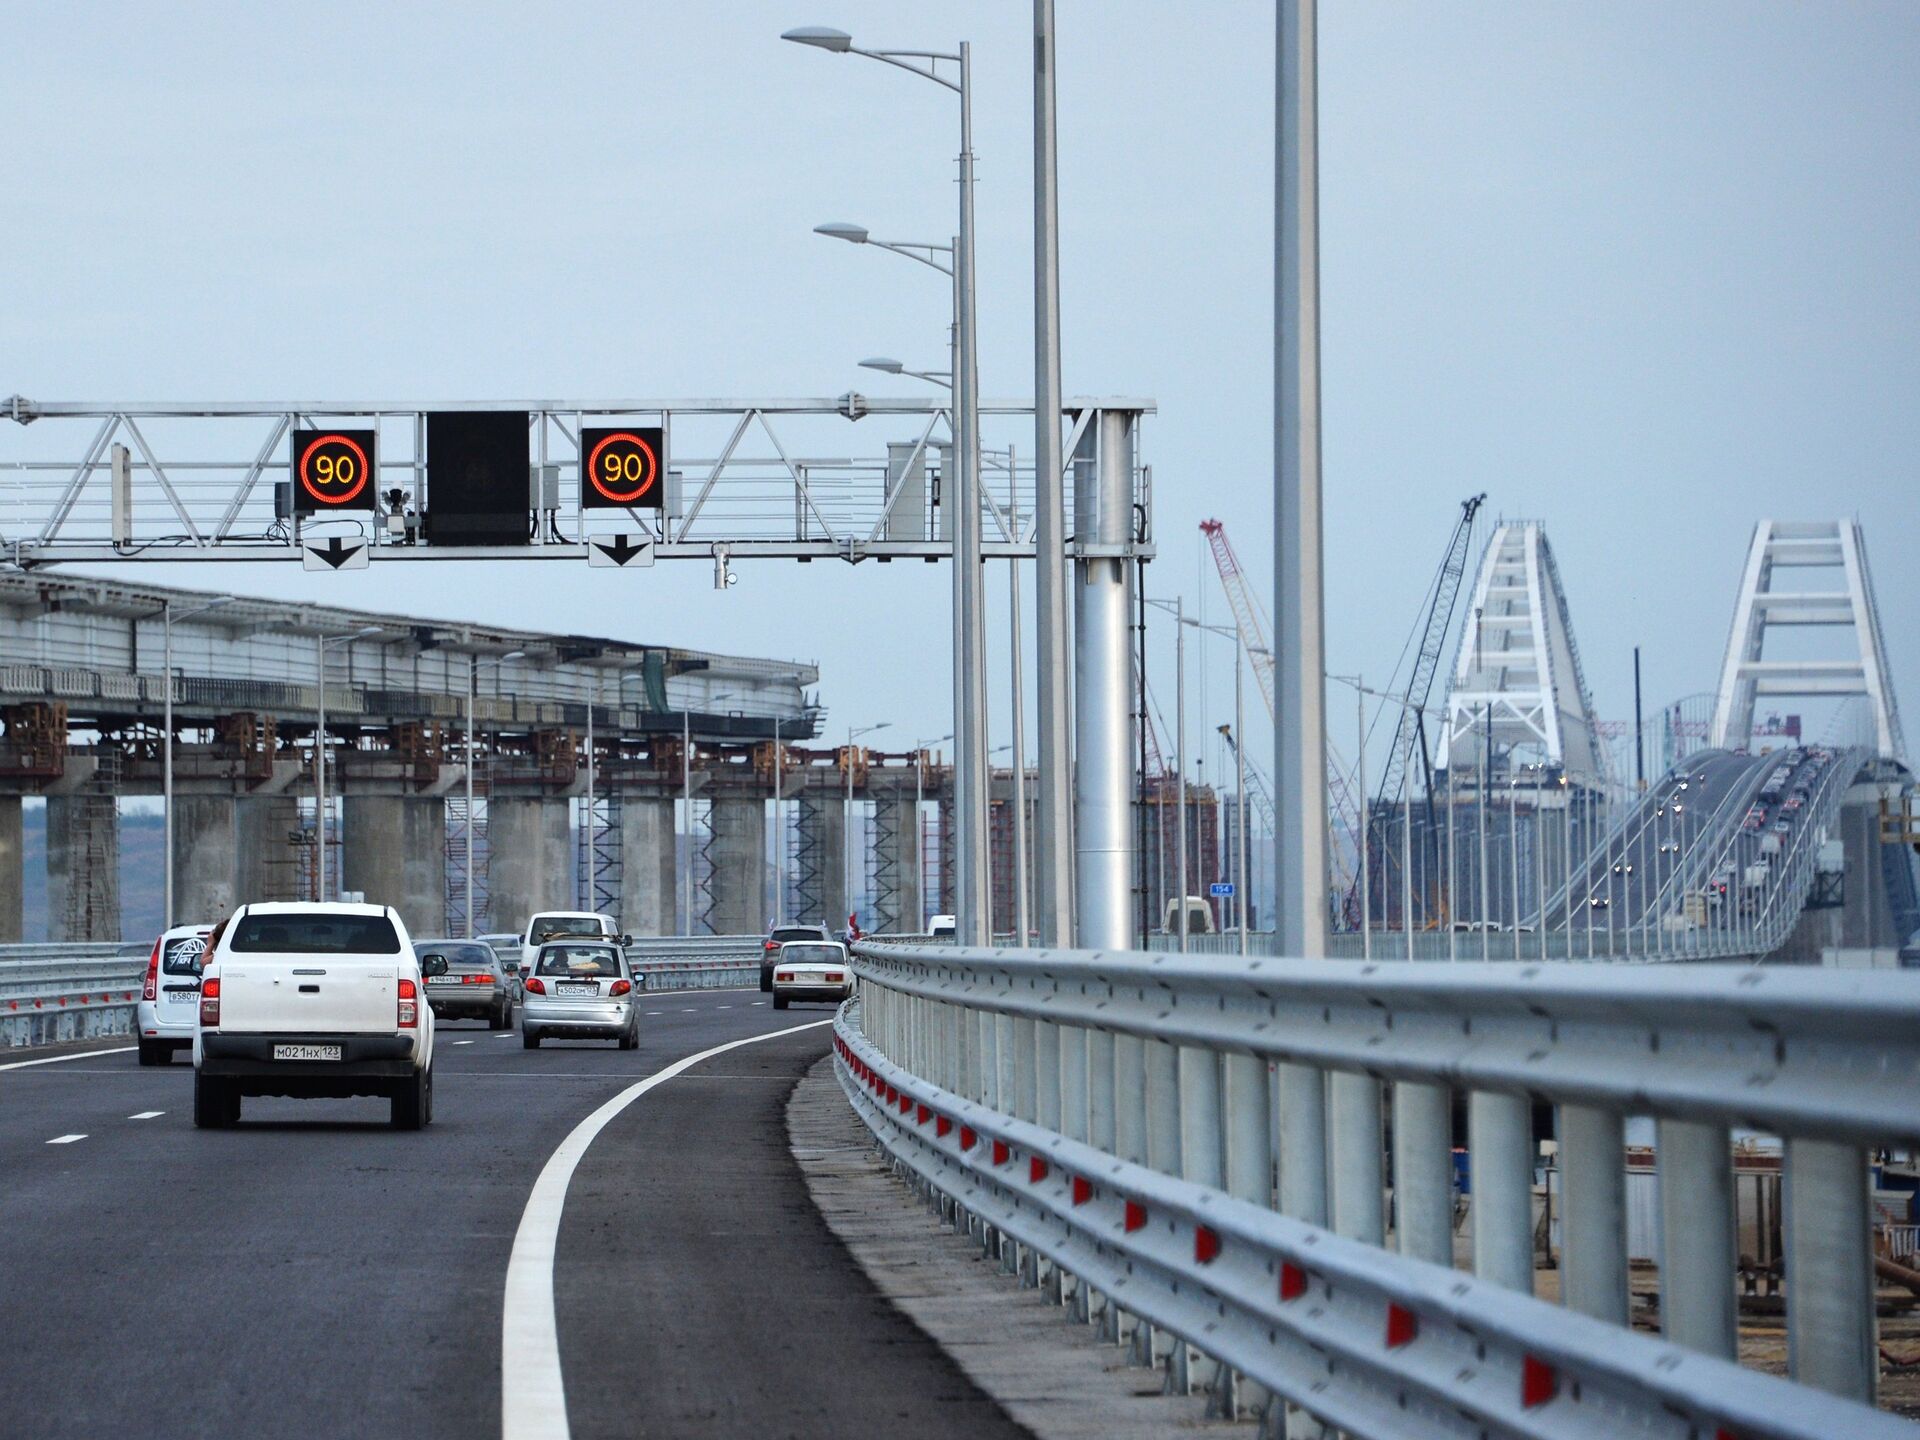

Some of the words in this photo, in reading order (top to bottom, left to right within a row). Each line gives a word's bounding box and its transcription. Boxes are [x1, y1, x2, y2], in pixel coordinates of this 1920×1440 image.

[316, 455, 354, 484] 90
[605, 453, 642, 481] 90
[322, 1046, 339, 1056] 123
